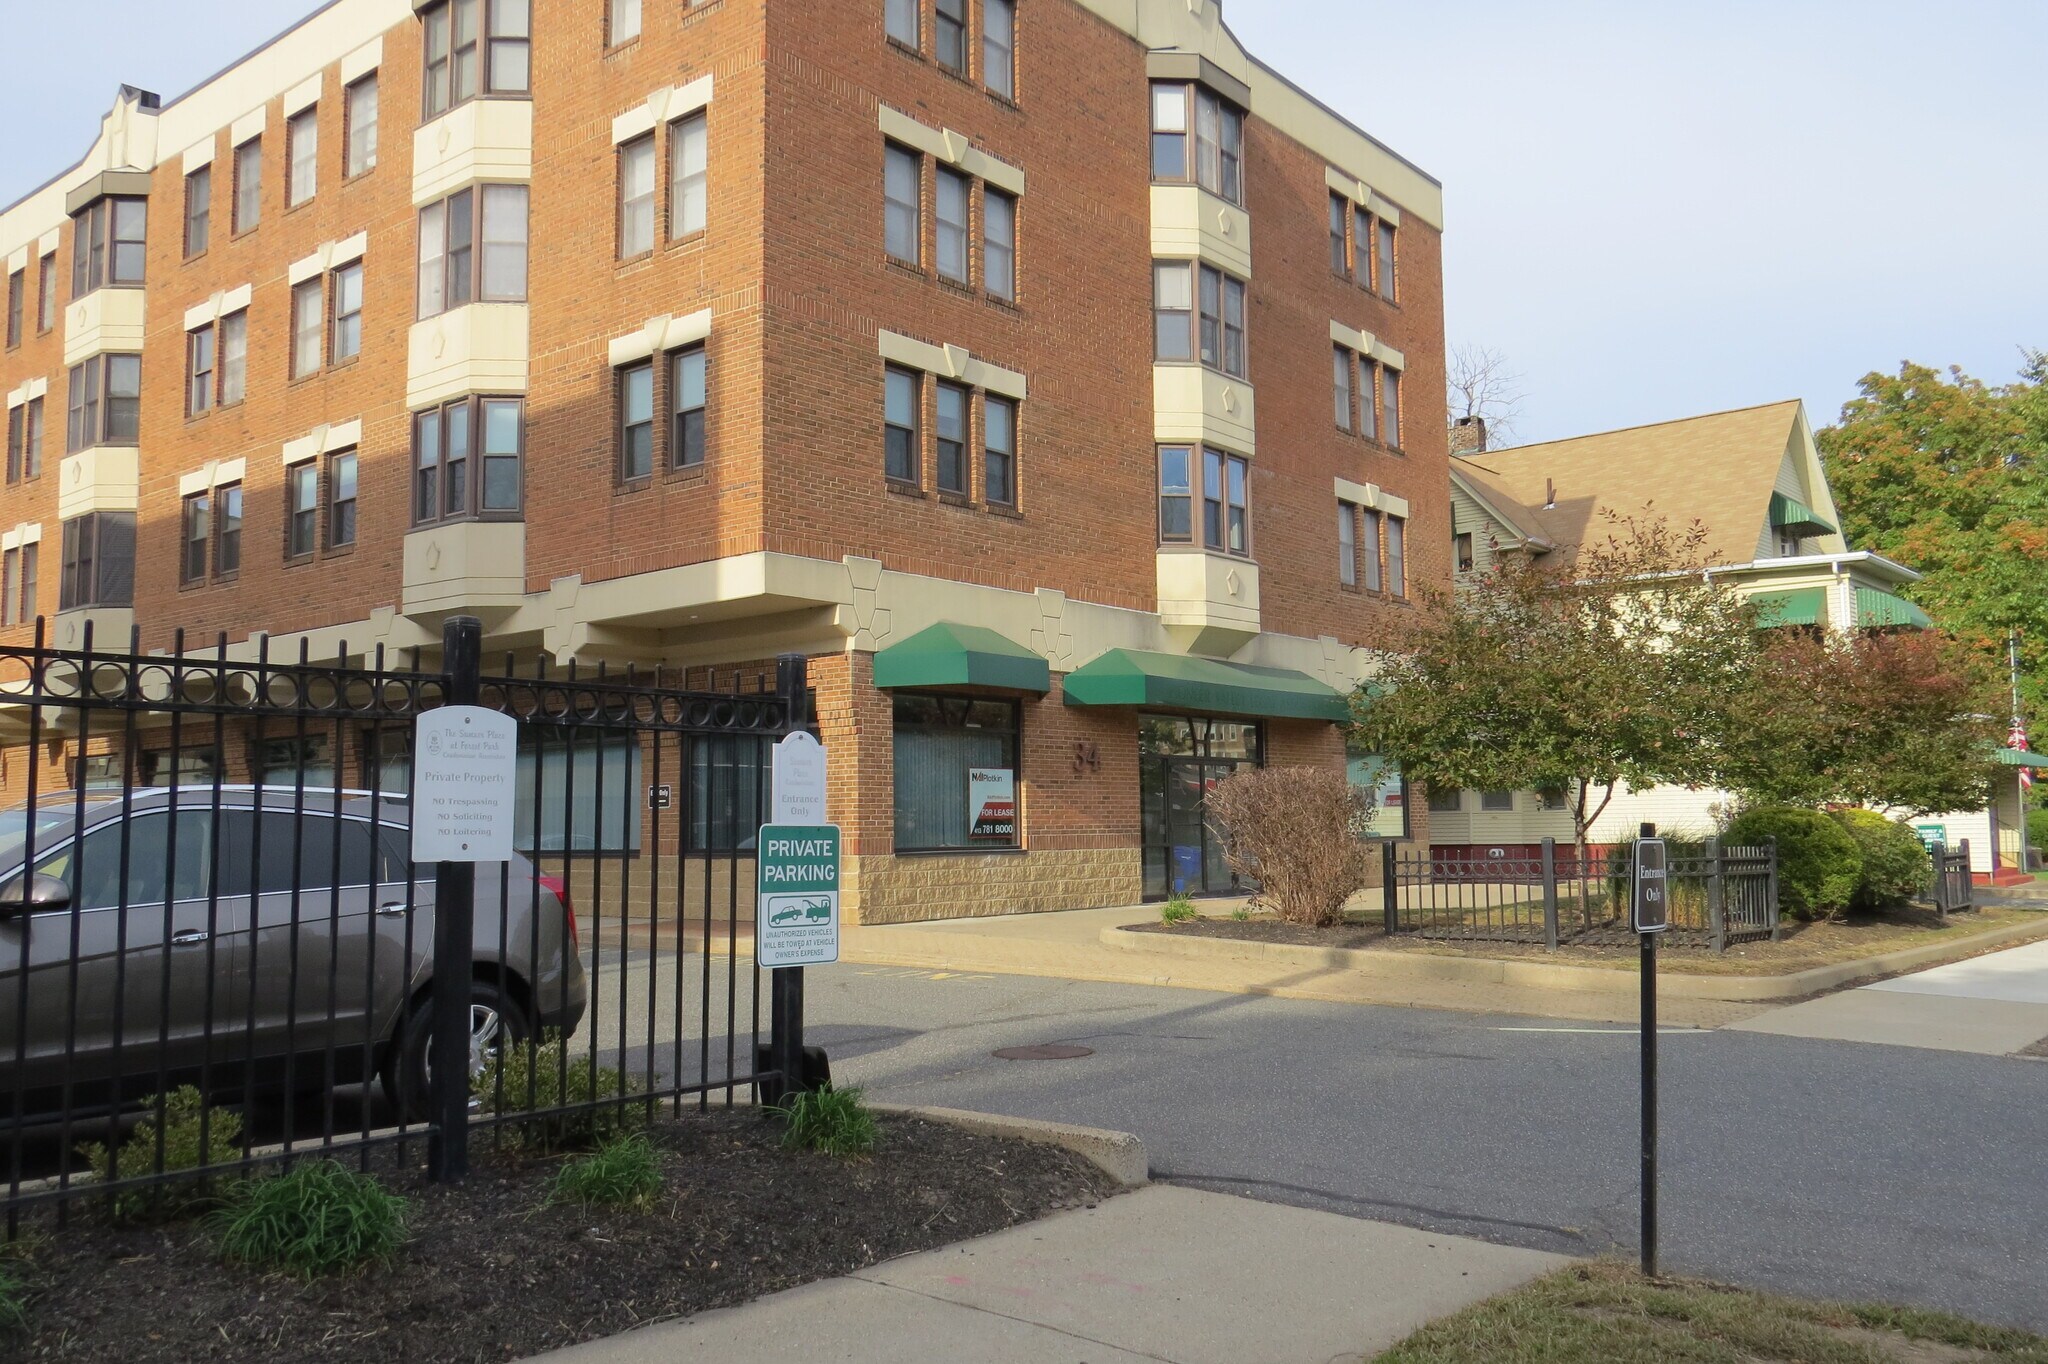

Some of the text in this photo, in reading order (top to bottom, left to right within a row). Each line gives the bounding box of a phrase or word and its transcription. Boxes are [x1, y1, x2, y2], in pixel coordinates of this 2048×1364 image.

[1073, 743, 1101, 772] 34
[424, 771, 505, 784] Private Property
[448, 797, 498, 807] Trespassing
[781, 794, 819, 803] Entrance
[790, 806, 809, 817] Only
[994, 808, 1014, 816] LEASE
[453, 812, 493, 822] Soliciting
[453, 828, 492, 837] Loitering
[982, 824, 993, 834] 781
[995, 824, 1013, 834] 8000
[768, 839, 833, 857] PRIVATE
[764, 864, 836, 883] PARKING
[765, 928, 833, 939] UNAUTHORIZED VEHICLES
[763, 938, 835, 949] WILL BE TOWED AT VEHICLE
[800, 949, 824, 957] EXPENSE
